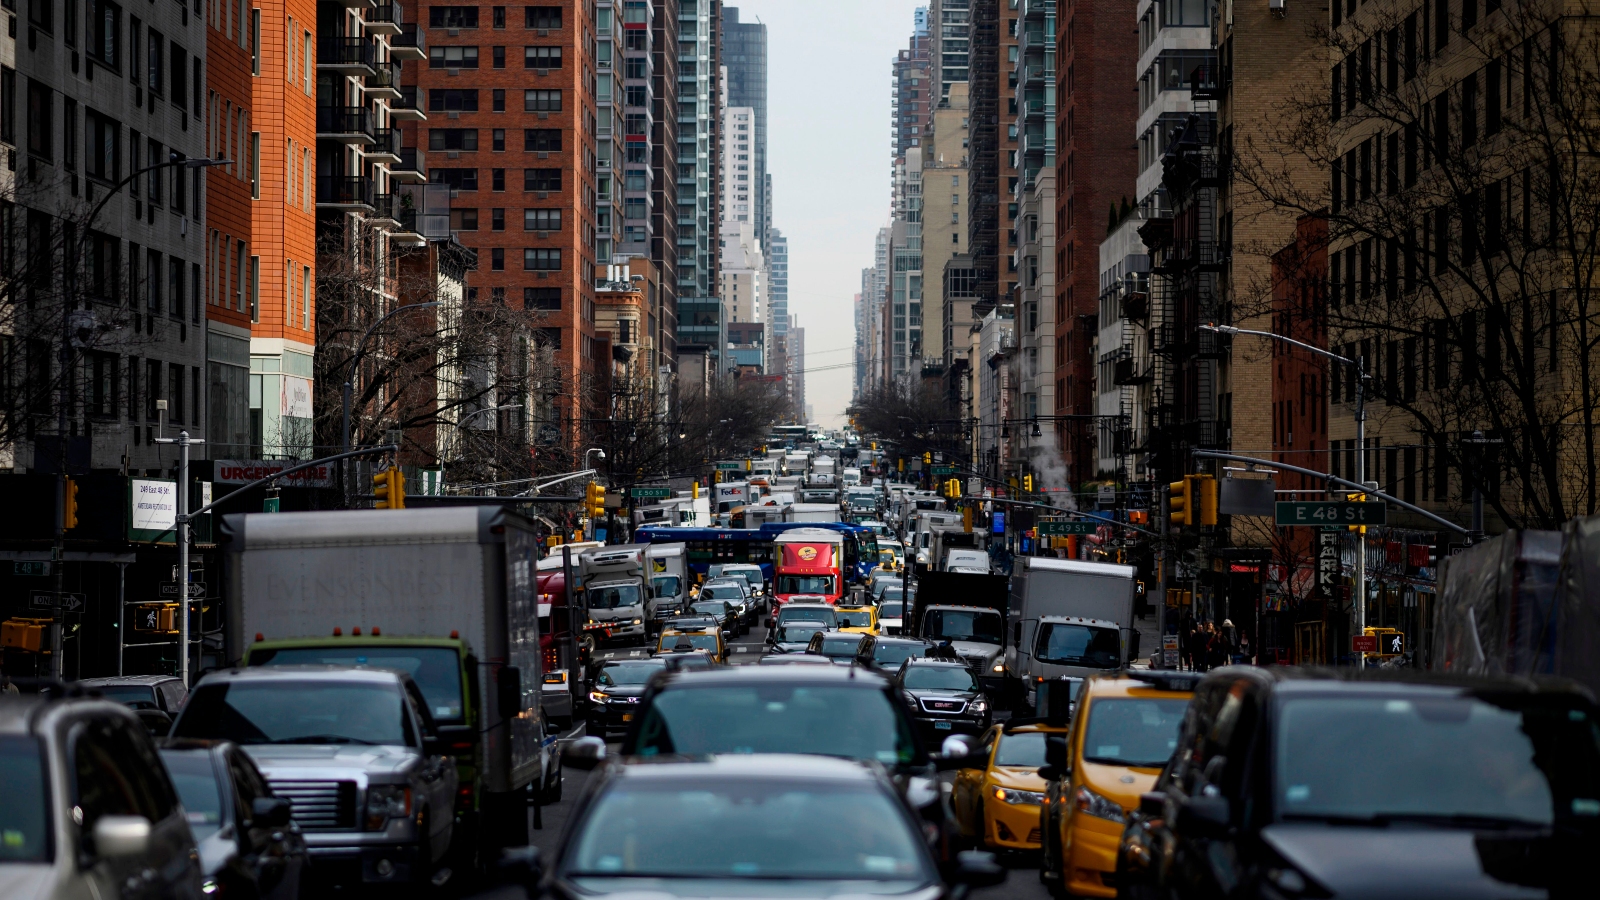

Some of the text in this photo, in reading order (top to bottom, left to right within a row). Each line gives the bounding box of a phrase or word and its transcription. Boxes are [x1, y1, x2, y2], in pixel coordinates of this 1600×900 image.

[221, 467, 327, 480] URGENT CARE
[148, 486, 157, 494] East
[1296, 506, 1366, 520] E 48 St
[1049, 524, 1086, 532] E 49 St
[1319, 533, 1338, 585] PARK
[14, 562, 20, 573] E
[21, 562, 32, 574] 48
[38, 596, 53, 605] ONE
